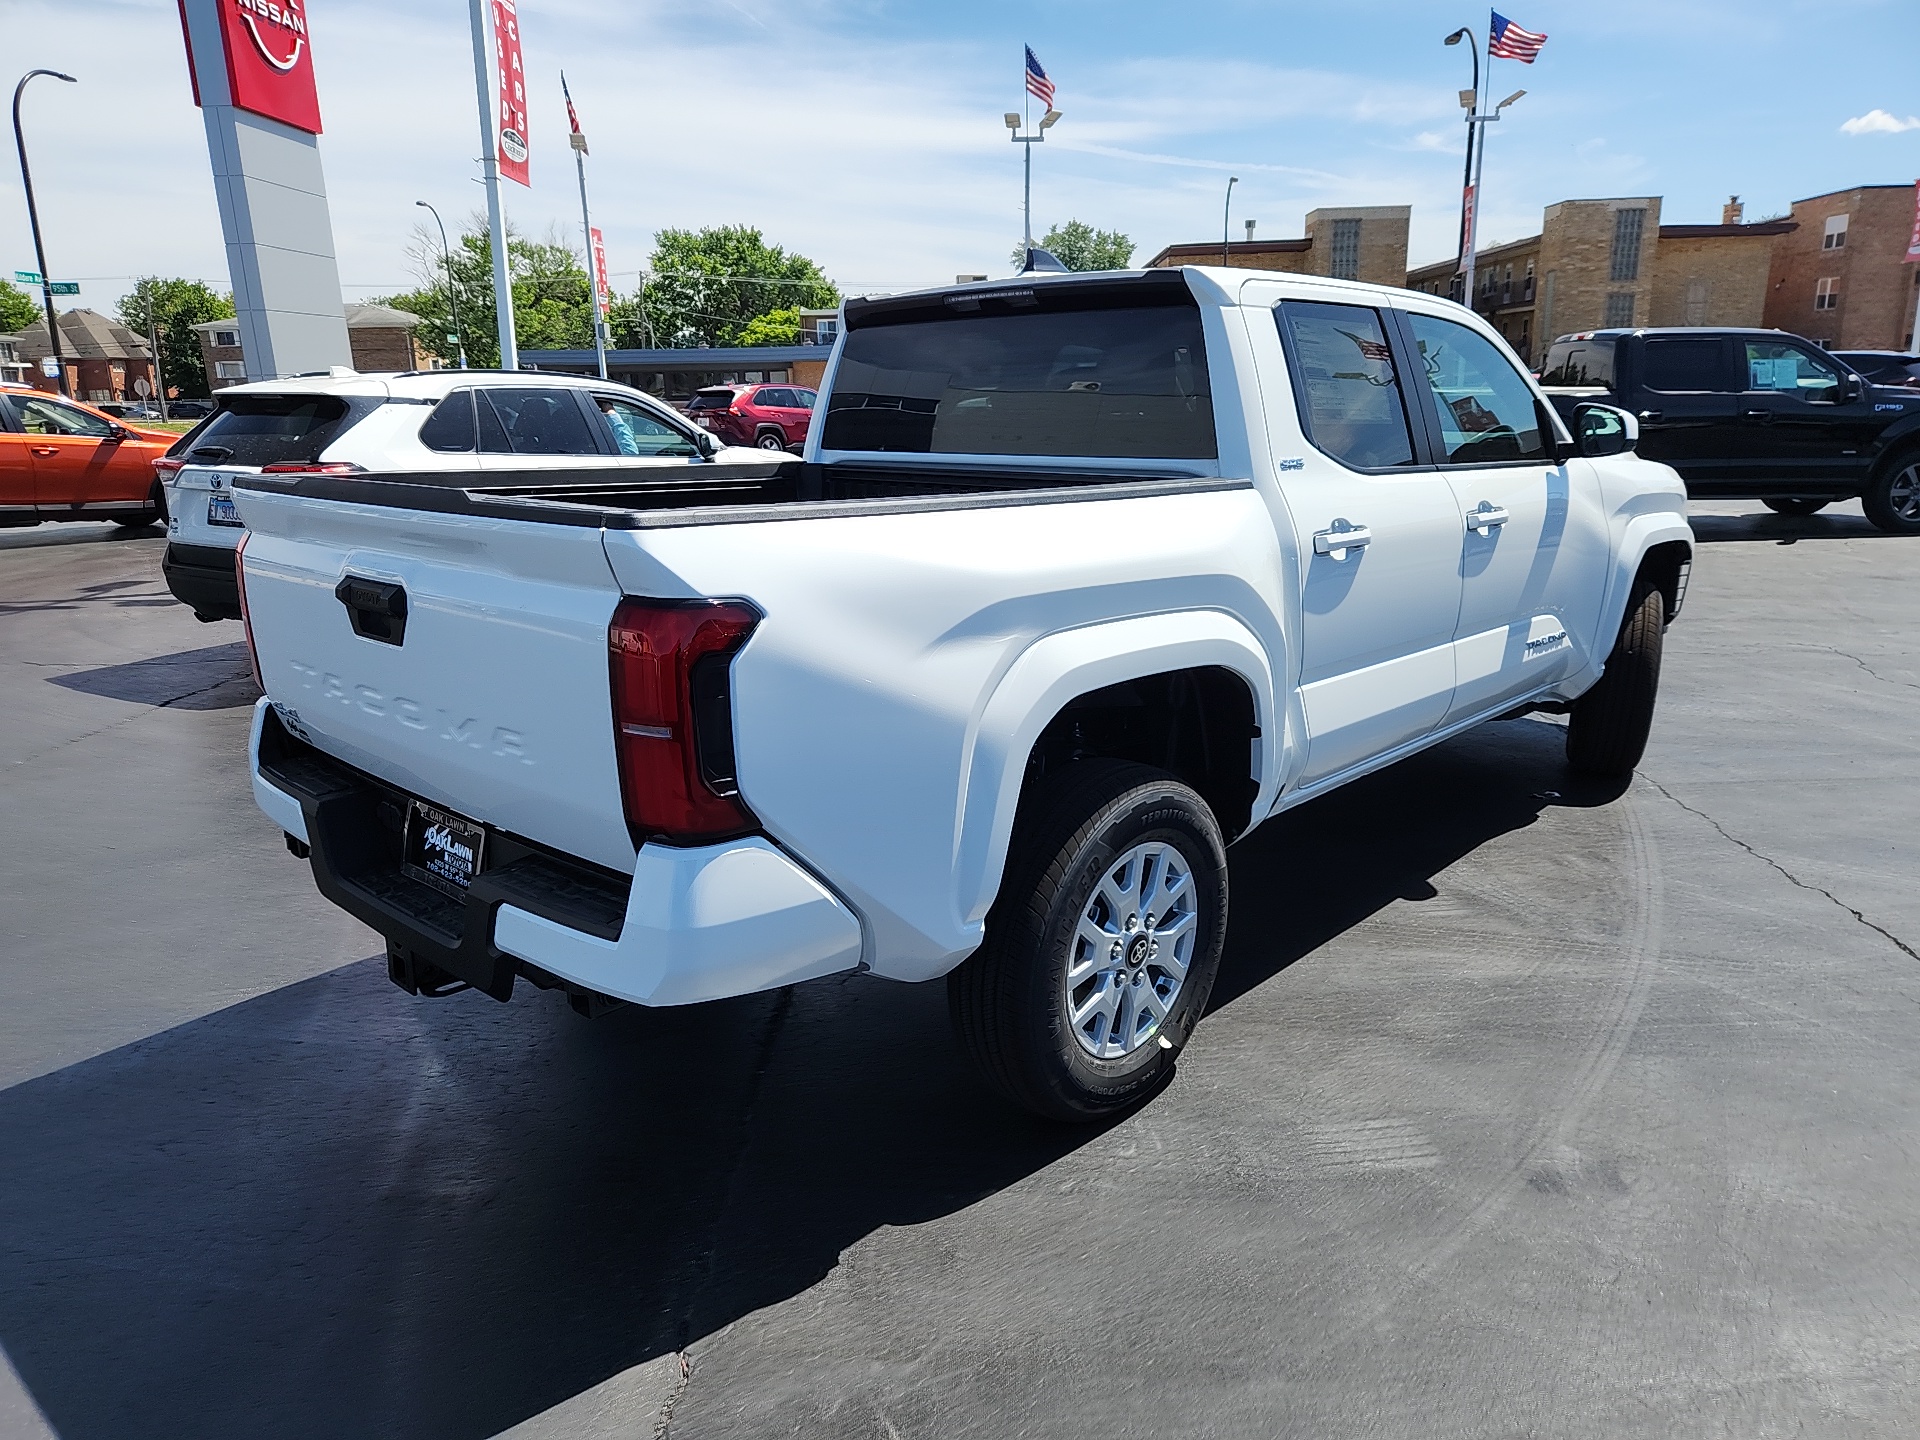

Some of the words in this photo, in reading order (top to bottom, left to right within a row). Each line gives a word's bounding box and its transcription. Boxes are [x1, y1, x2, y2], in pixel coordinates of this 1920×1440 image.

[237, 0, 305, 35] NISSAN
[492, 4, 509, 121] USED
[507, 20, 525, 132] CARS
[52, 284, 69, 293] 95th
[69, 284, 79, 293] St
[1525, 631, 1567, 652] TACOMA
[288, 658, 537, 766] TACOMA
[429, 810, 444, 824] OAK
[445, 816, 466, 833] LAWN
[1140, 807, 1196, 827] TERRITORY
